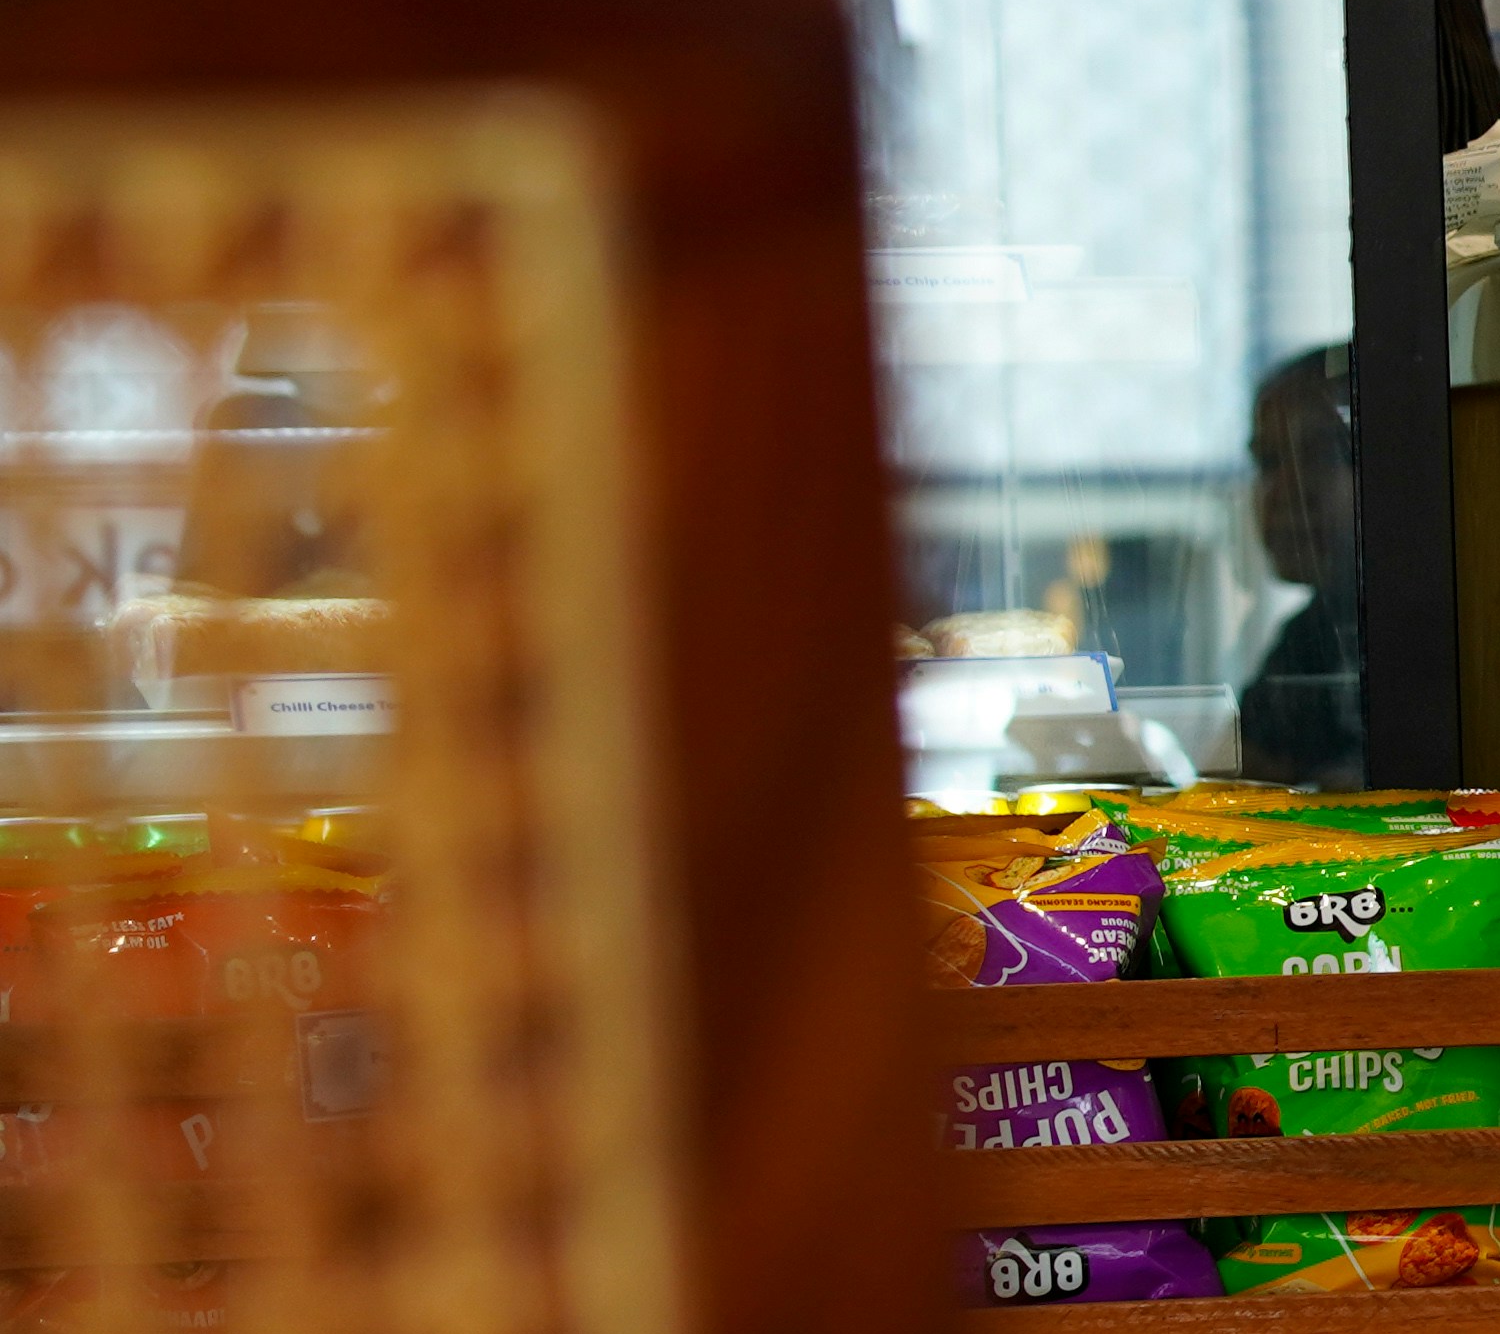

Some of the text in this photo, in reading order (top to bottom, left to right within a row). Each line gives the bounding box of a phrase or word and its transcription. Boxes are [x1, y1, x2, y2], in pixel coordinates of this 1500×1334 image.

[271, 701, 313, 713] Chilli
[317, 701, 375, 712] Cheese
[1087, 898, 1132, 908] OREGANO
[1289, 891, 1382, 938] BRB
[953, 1061, 1074, 1114] CHIPS
[1289, 1051, 1405, 1093] CHIPS
[990, 1237, 1084, 1299] BRB
